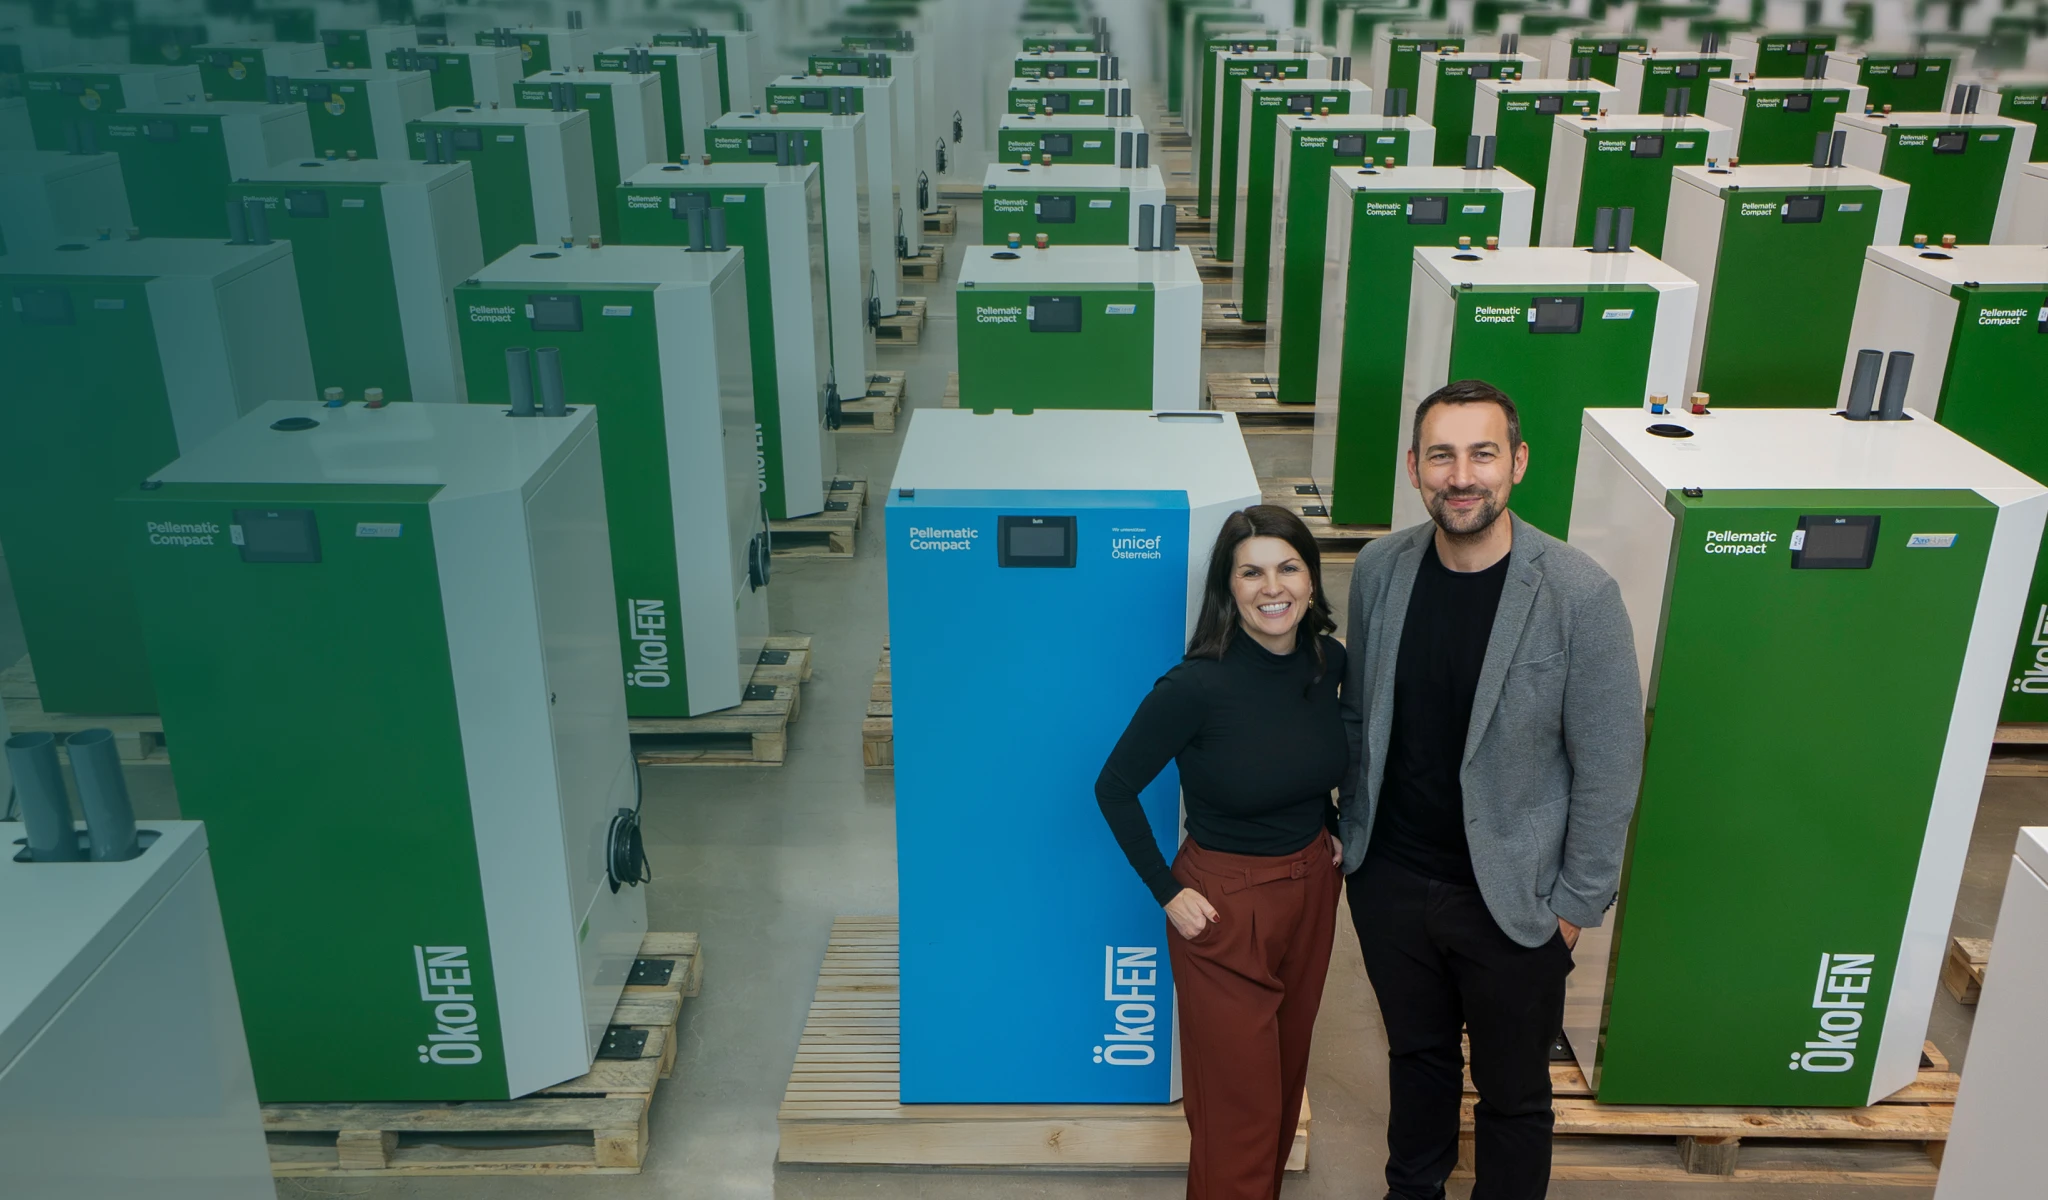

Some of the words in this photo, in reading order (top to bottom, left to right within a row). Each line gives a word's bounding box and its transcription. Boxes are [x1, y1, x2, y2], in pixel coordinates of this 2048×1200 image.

[470, 306, 515, 314] Pellematic
[977, 306, 1022, 315] Pellematic
[1476, 307, 1520, 315] Pellematic
[1980, 309, 2028, 317] Pellematic
[471, 314, 512, 323] Compact
[977, 314, 1017, 324] Compact
[1475, 315, 1515, 324] Compact
[1979, 317, 2020, 326] Compact
[147, 521, 220, 534] Pellematic
[910, 527, 979, 539] Pellematic
[151, 534, 214, 547] Compact
[1112, 535, 1161, 550] unicef
[1707, 531, 1777, 543] Pellematic
[910, 539, 970, 552] Compact
[1705, 543, 1768, 556] Compact
[1112, 548, 1161, 560] Österreich
[627, 598, 670, 688] ÖkoFEN
[413, 945, 483, 1065] ÖkoFEN
[1093, 945, 1157, 1066] ÖkoFEN
[1789, 952, 1875, 1073] ÖkoFEN
